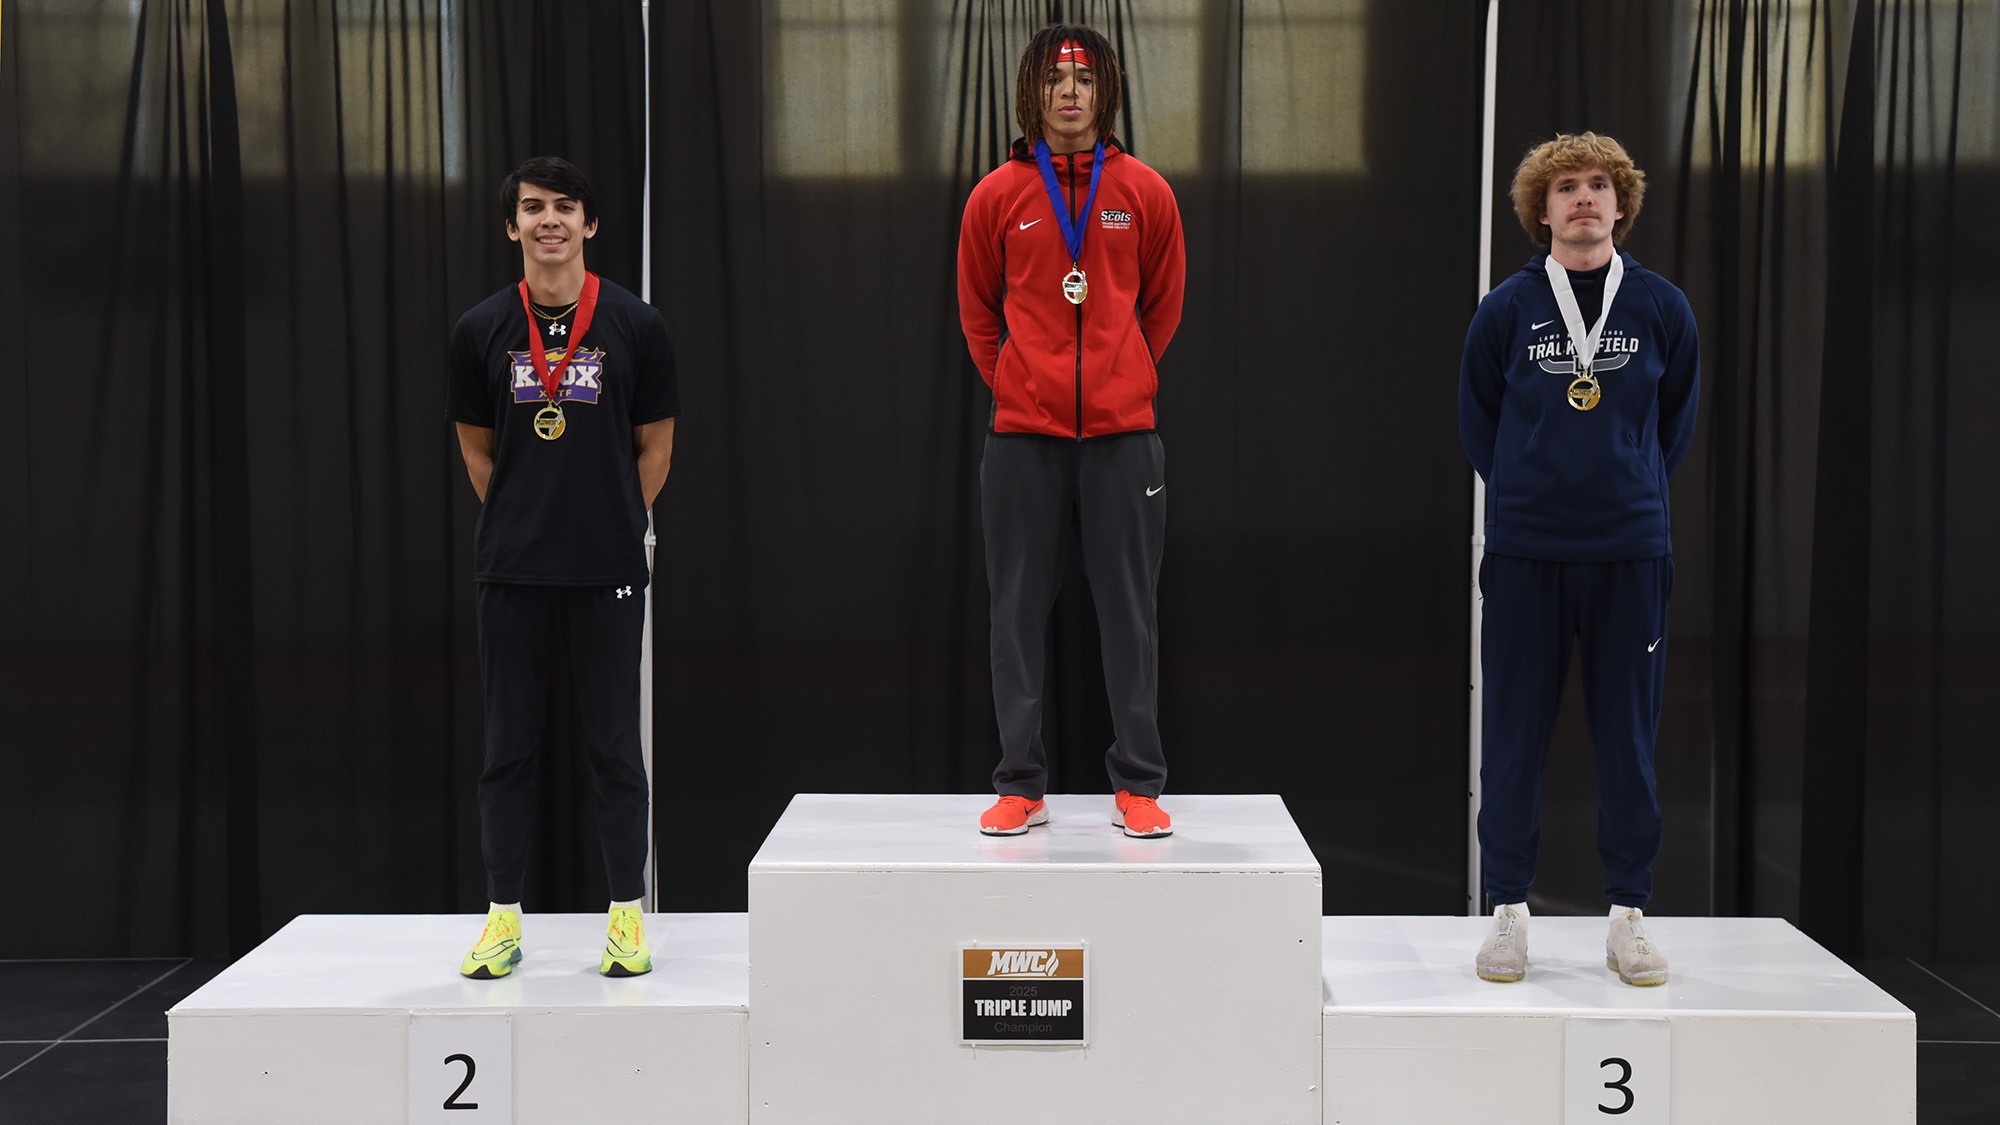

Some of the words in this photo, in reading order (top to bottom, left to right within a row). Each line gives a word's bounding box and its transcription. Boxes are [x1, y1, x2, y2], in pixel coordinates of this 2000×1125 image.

[1101, 210, 1131, 222] Scots
[1596, 338, 1639, 353] FIELD
[987, 951, 1048, 976] MWC
[1009, 986, 1038, 997] 2025
[974, 999, 1027, 1017] TRIPLE
[1029, 999, 1072, 1017] JUMP
[994, 1022, 1052, 1034] Champion
[443, 1053, 479, 1110] 2
[1598, 1057, 1635, 1115] 3
